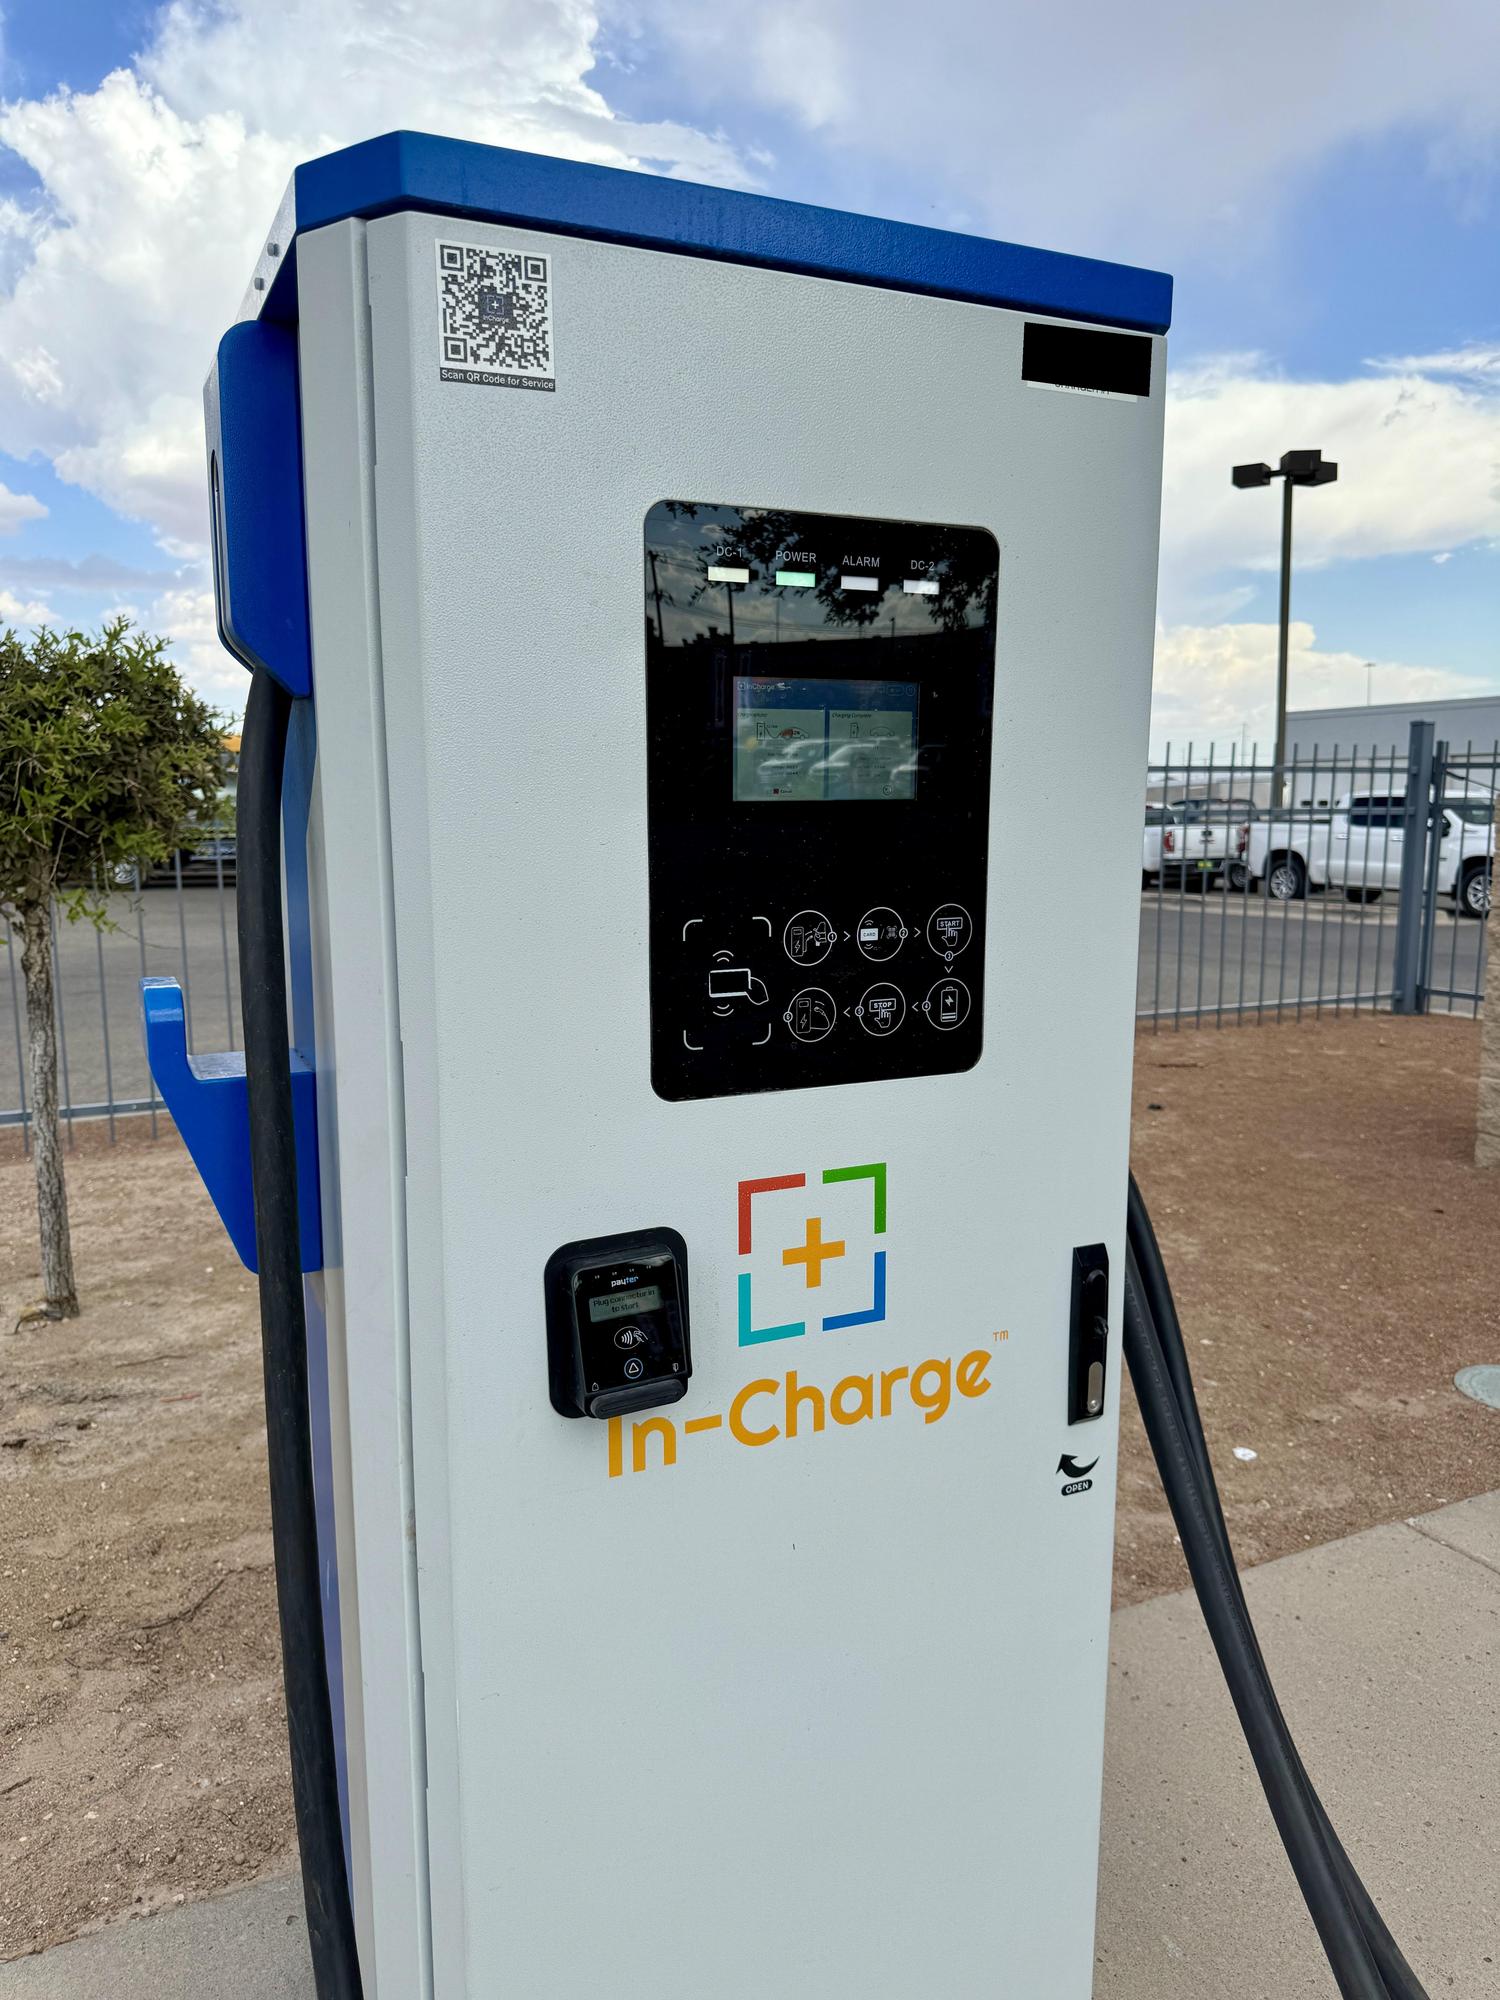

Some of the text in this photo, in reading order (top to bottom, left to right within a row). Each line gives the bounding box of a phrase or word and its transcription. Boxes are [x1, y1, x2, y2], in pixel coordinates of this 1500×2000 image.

[441, 369, 554, 389] Scan QR Code for Service
[716, 546, 743, 558] DC-1
[775, 550, 817, 564] POWER
[842, 555, 880, 568] ALARM
[910, 560, 935, 571] DC-2
[611, 1276, 639, 1288] payter
[593, 1298, 609, 1307] Plug
[612, 1302, 639, 1313] to start
[608, 1349, 992, 1478] In-Charge
[1065, 1481, 1089, 1494] OPEN
